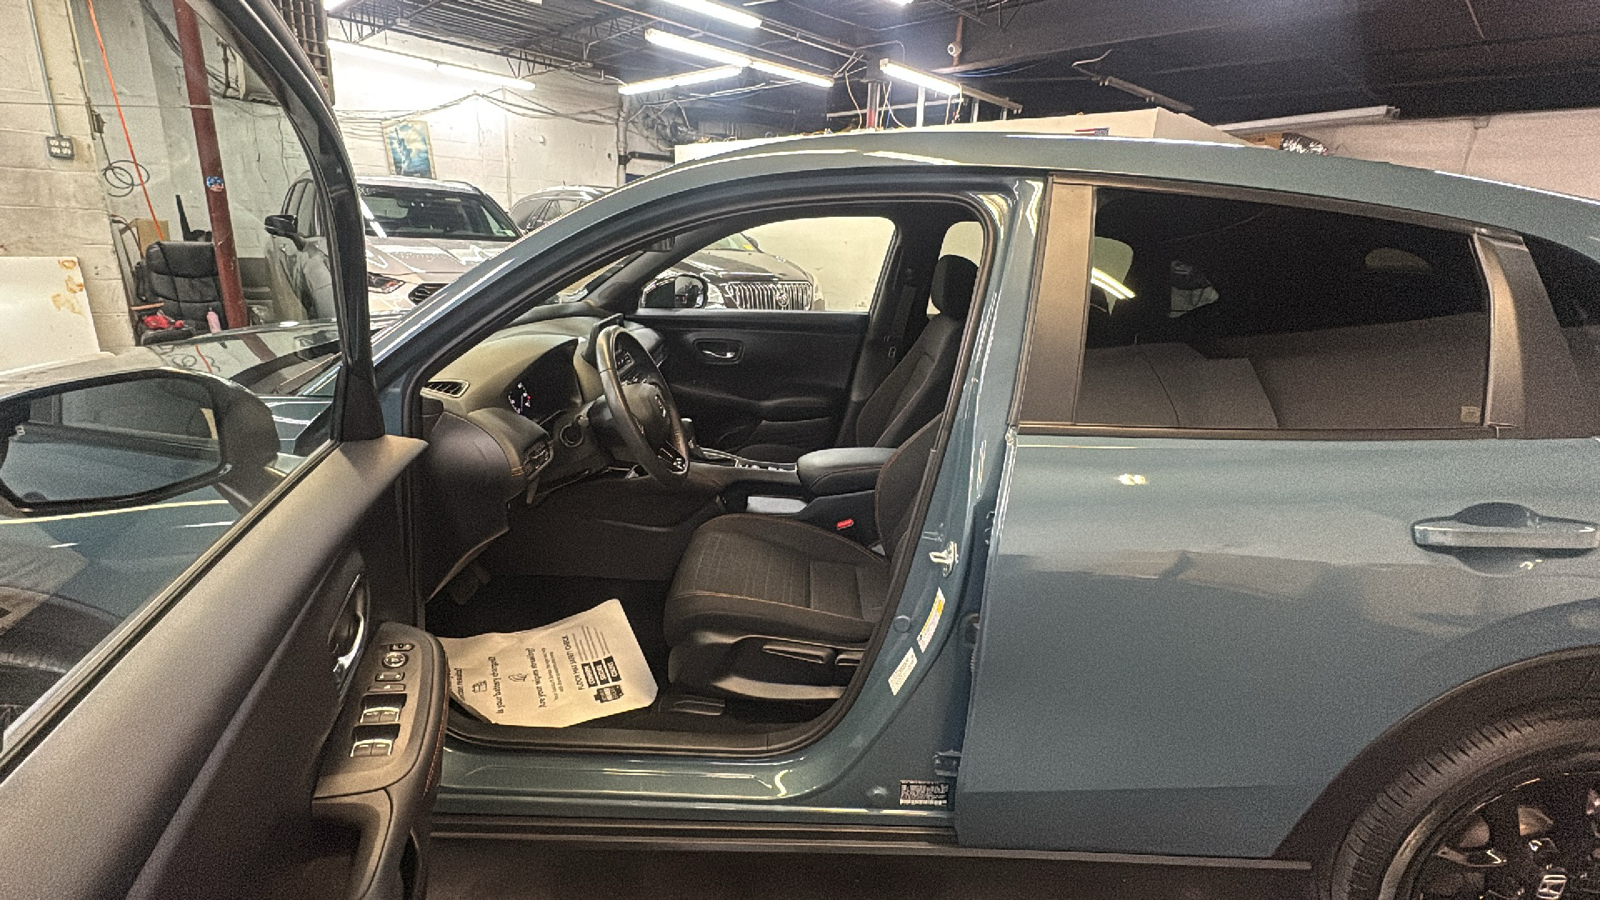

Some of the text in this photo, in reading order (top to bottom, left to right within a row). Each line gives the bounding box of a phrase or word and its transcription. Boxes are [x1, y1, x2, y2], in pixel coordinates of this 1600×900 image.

[562, 635, 571, 650] CHECK
[488, 656, 498, 677] charged?
[571, 665, 579, 674] MAT
[493, 678, 501, 696] battery
[575, 675, 584, 691] FLOOR
[536, 686, 546, 698] your
[494, 696, 505, 708] your
